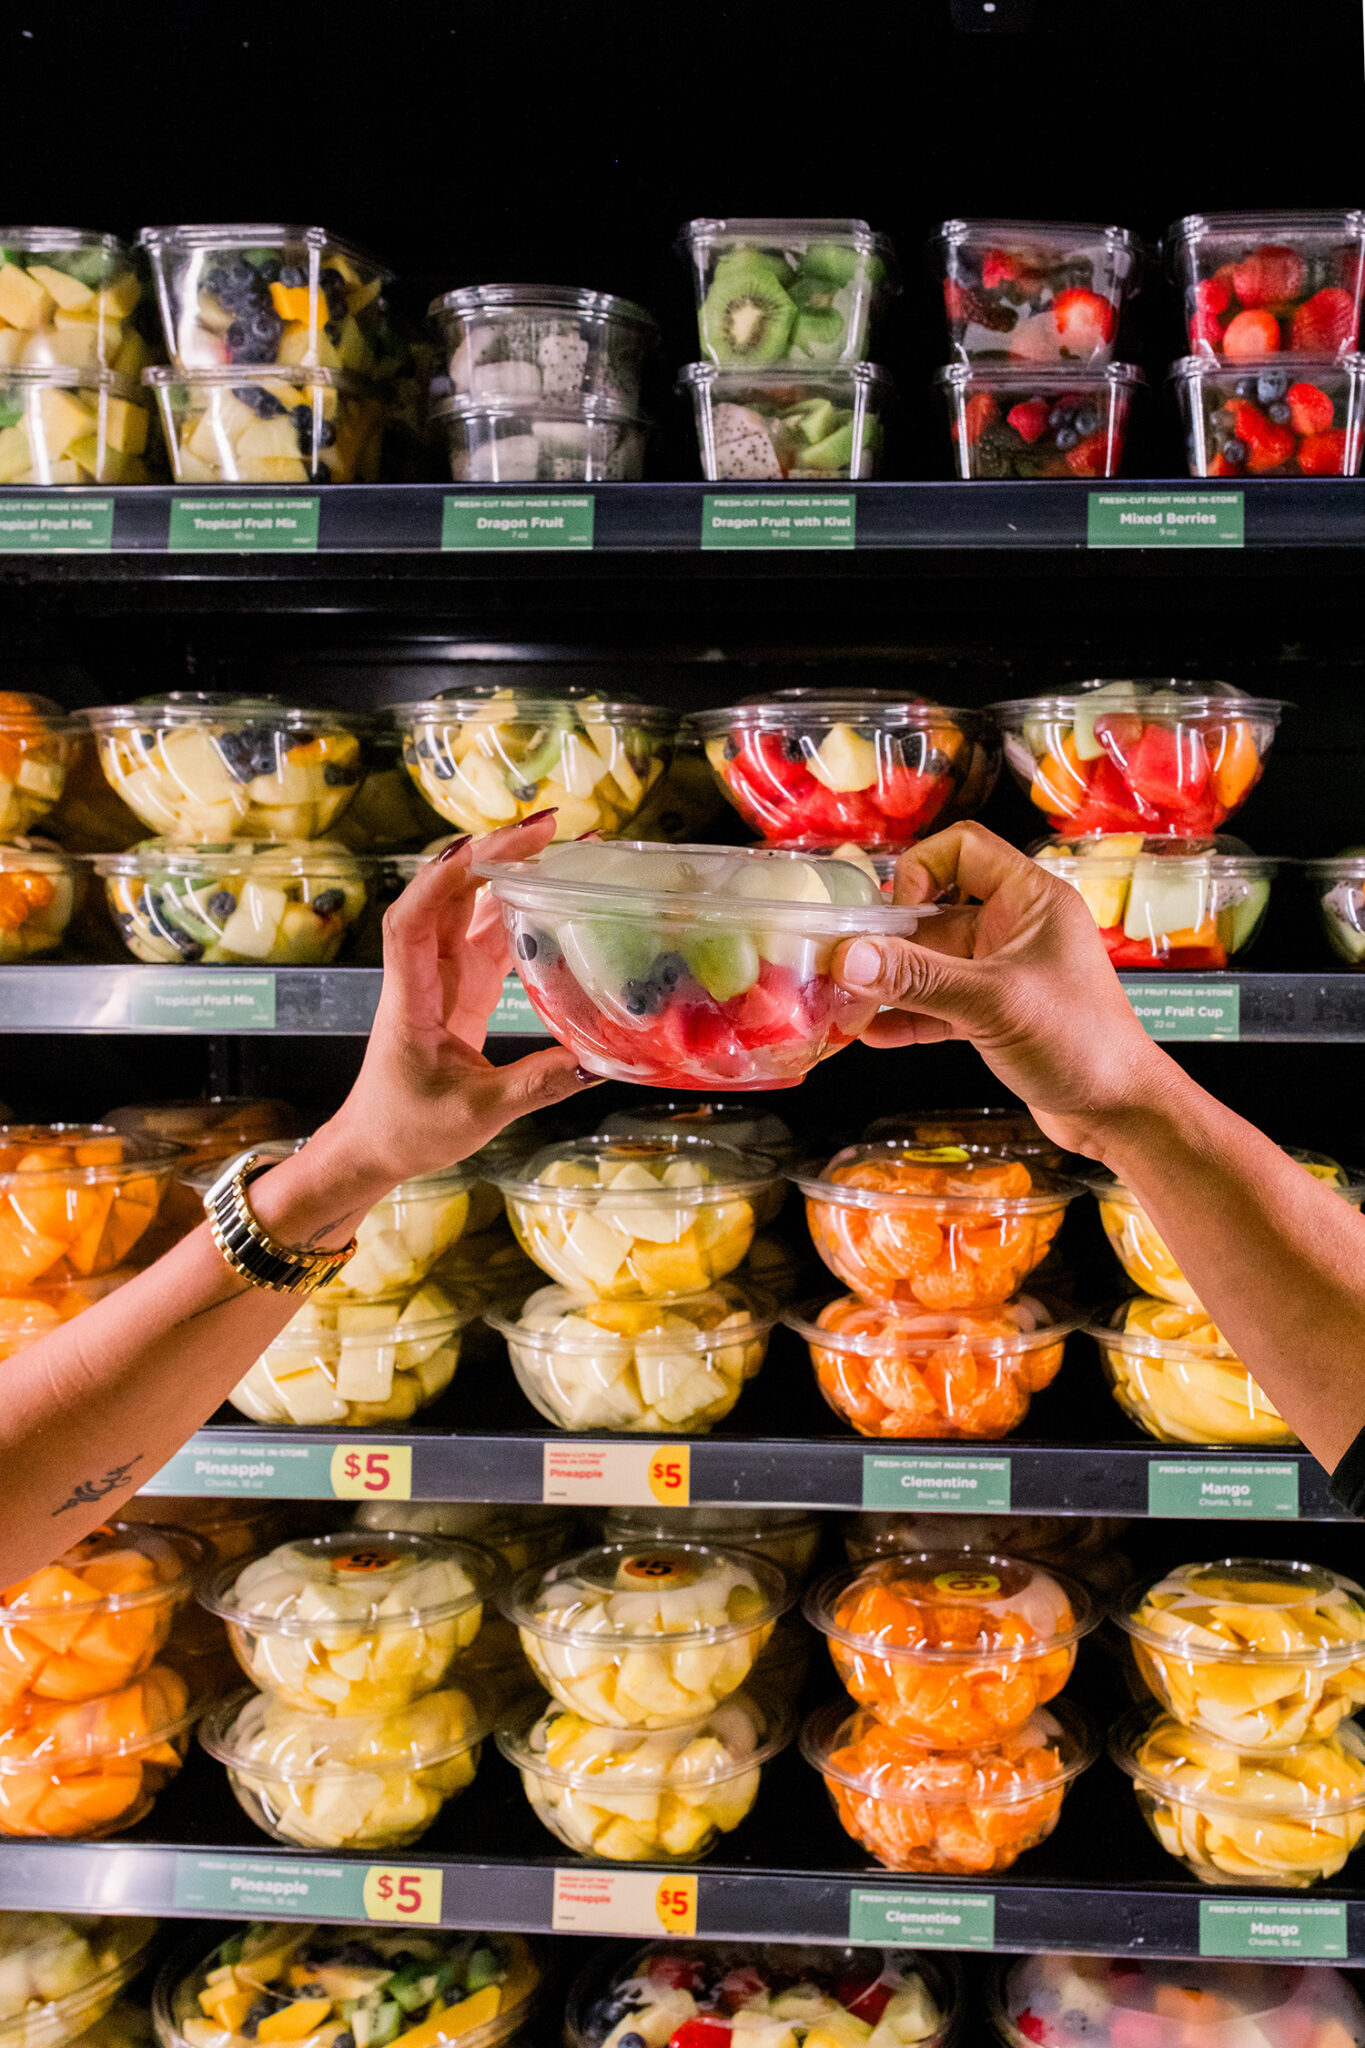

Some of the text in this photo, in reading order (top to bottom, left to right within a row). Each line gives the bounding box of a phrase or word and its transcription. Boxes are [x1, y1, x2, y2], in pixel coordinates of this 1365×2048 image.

[40, 519, 68, 529] Fruit
[71, 519, 92, 529] Mix
[194, 518, 297, 530] Tropical Fruit Mix
[477, 517, 564, 530] Dragon Fruit
[712, 516, 851, 529] Dragon Fruit with Kiwi
[1120, 512, 1217, 524] Mixed Berries
[1145, 988, 1168, 996] FRUIT
[154, 995, 254, 1007] Tropical Fruit Mix
[507, 998, 532, 1008] Frui
[1165, 1006, 1194, 1017] Fruit
[1198, 1006, 1224, 1019] Cup
[195, 1461, 275, 1477] Pineapple
[344, 1452, 390, 1491] $5
[920, 1461, 942, 1469] FRUIT
[944, 1462, 966, 1470] MADE
[1205, 1466, 1228, 1474] FRUIT
[1230, 1466, 1253, 1474] MADE
[549, 1468, 603, 1480] Pineapple
[653, 1463, 682, 1489] $5
[901, 1475, 978, 1489] Clementine
[1202, 1482, 1250, 1497] Mango
[230, 1876, 309, 1895] Pineapple
[377, 1874, 422, 1913] $5
[559, 1892, 611, 1904] Pineapple
[660, 1890, 688, 1915] $5
[1254, 1906, 1277, 1914] FRUIT
[885, 1910, 961, 1925] Clementine
[1251, 1922, 1299, 1937] Mango
